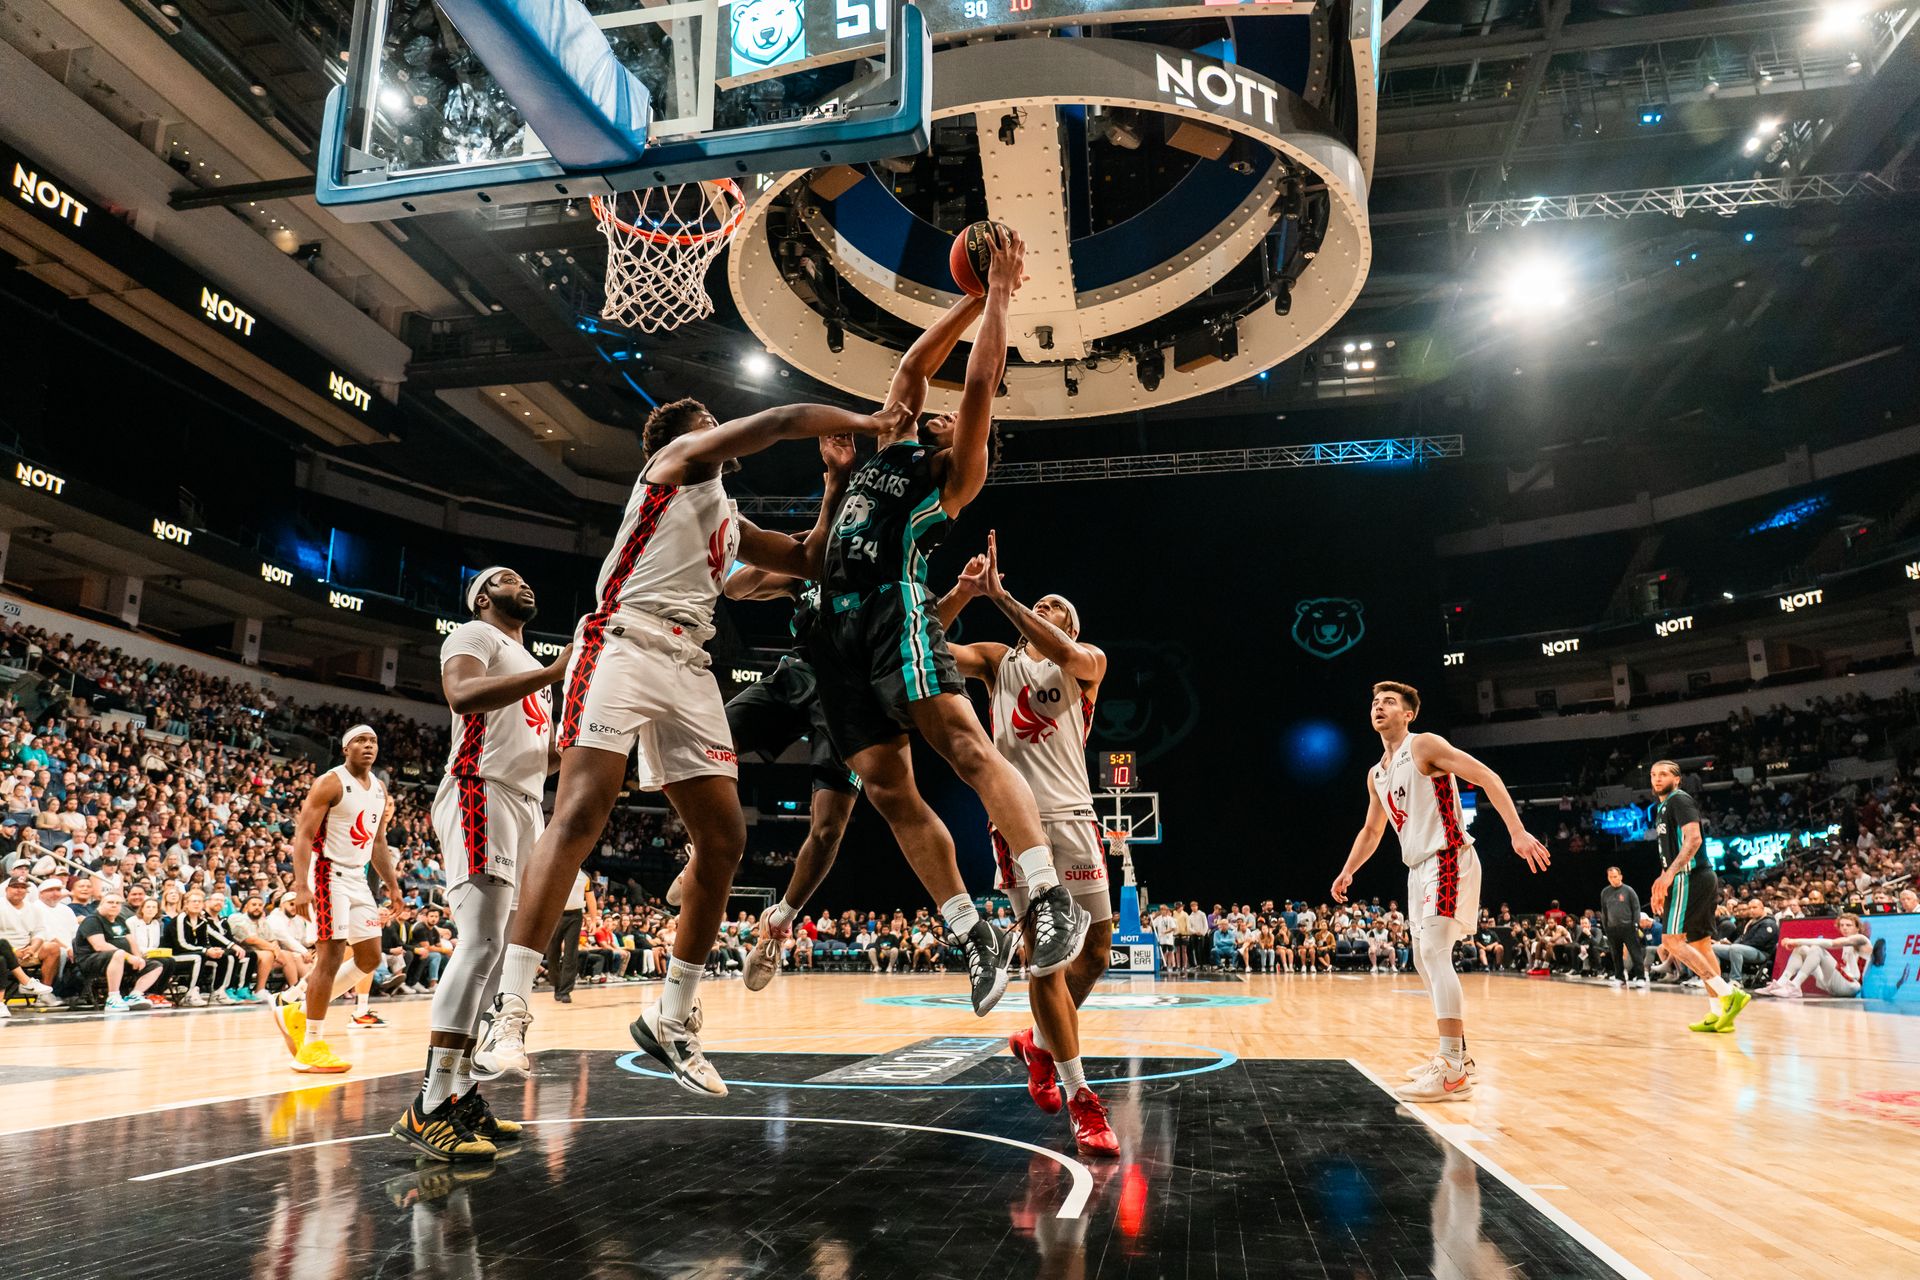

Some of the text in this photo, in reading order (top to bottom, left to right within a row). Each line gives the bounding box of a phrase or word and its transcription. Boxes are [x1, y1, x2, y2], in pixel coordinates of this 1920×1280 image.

[964, 0, 988, 18] 3Q
[1156, 53, 1278, 125] NOTT
[13, 162, 88, 227] NOTT
[200, 286, 255, 336] NOTT
[329, 370, 371, 411] NOTT
[16, 462, 65, 494] NOTT
[153, 518, 192, 546] NOTT
[847, 536, 878, 564] 24
[261, 562, 294, 586] NOTT
[1905, 561, 1920, 580] N
[329, 590, 364, 612] NOTT
[1779, 589, 1823, 613] NOTT
[436, 618, 463, 634] NO
[1655, 615, 1693, 637] NOTT
[1542, 638, 1579, 656] NOTT
[1443, 652, 1464, 666] OTT
[731, 668, 763, 683] NOTT
[1036, 687, 1061, 704] 00
[1109, 753, 1132, 765] 5:27
[1114, 766, 1129, 785] 10
[371, 813, 378, 824] 3
[1065, 868, 1104, 881] SURGE
[1120, 935, 1140, 943] NOTT
[1133, 950, 1151, 958] NEW
